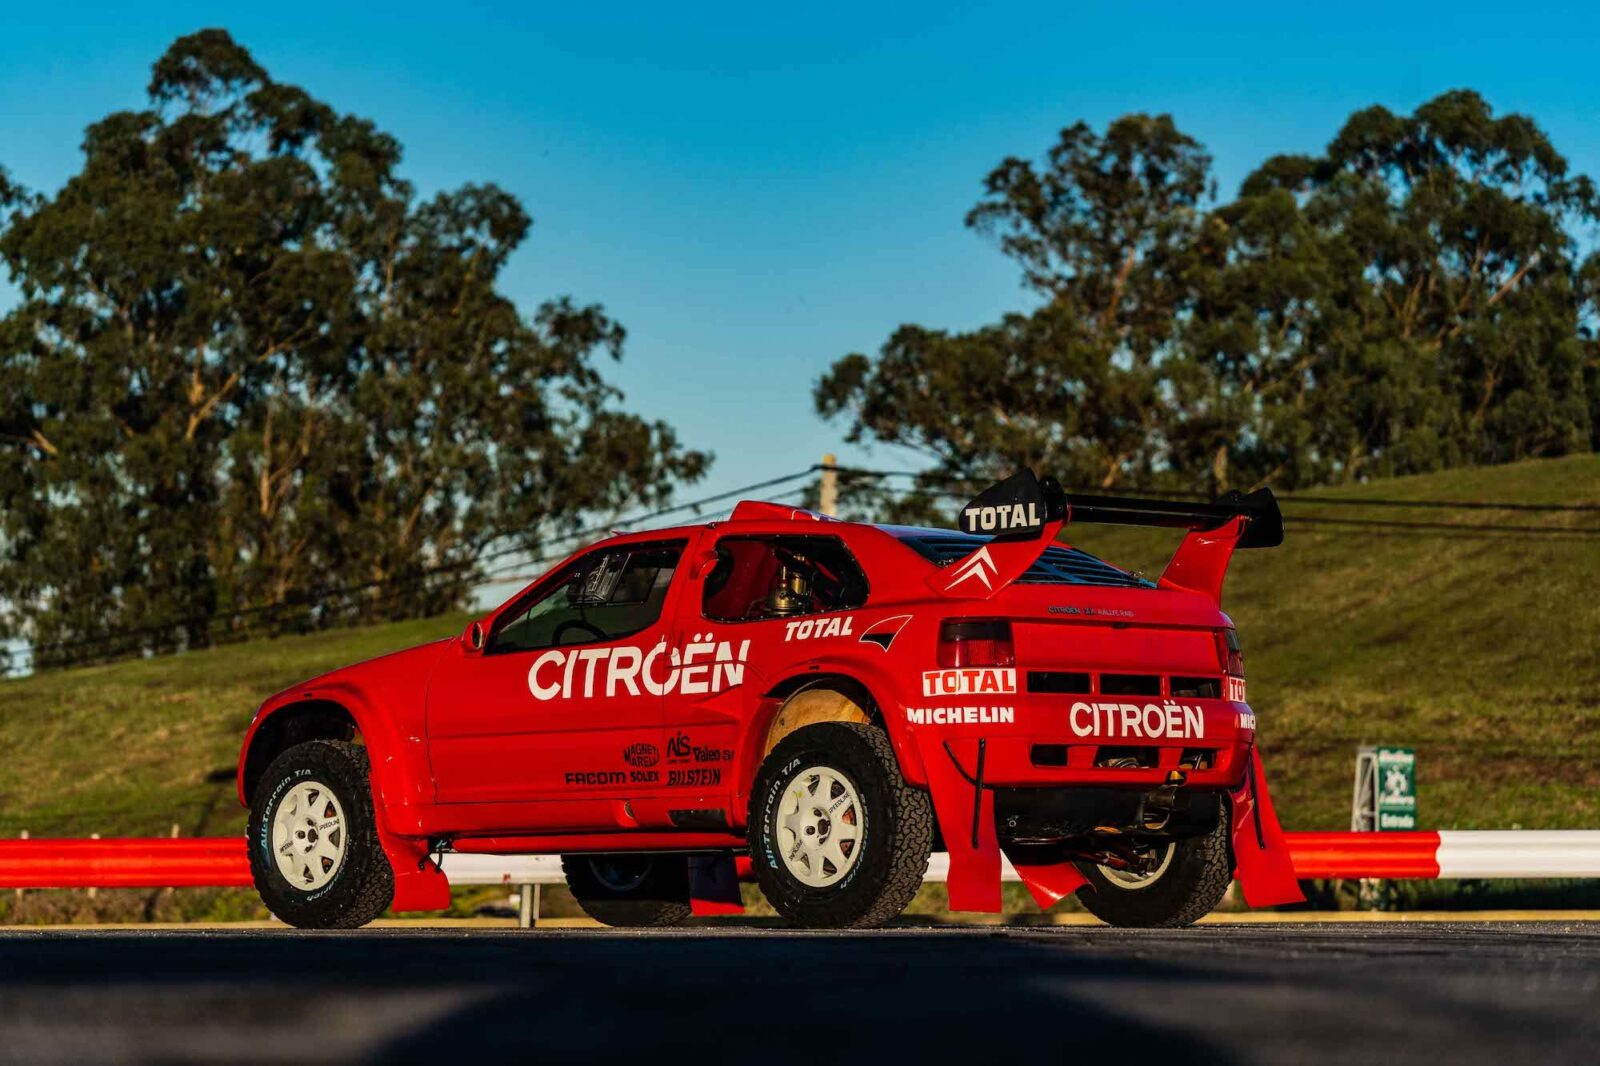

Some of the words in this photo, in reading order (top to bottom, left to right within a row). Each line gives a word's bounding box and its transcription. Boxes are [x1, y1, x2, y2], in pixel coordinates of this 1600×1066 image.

[965, 502, 1041, 532] TOTAL
[784, 616, 853, 641] TOTAL
[527, 632, 750, 700] CITROËN
[924, 669, 1015, 694] TOTAL
[906, 706, 1015, 724] MICHELIN
[1069, 700, 1204, 738] CITROËN
[294, 768, 312, 777] T/A
[565, 771, 627, 785] FACOM
[630, 770, 660, 783] SOLEX
[667, 768, 722, 787] BILSTEIN
[782, 758, 801, 776] T/A
